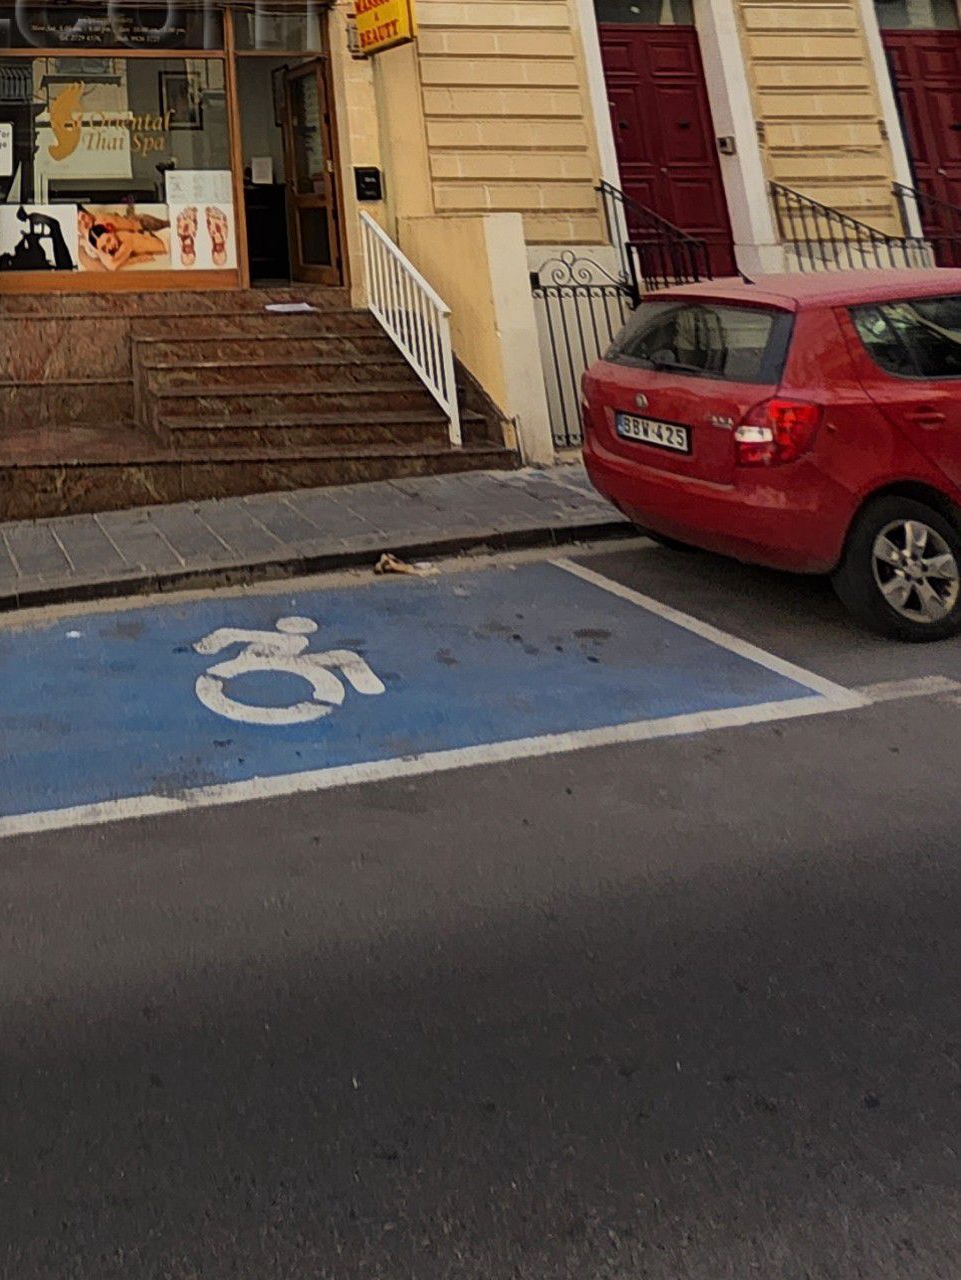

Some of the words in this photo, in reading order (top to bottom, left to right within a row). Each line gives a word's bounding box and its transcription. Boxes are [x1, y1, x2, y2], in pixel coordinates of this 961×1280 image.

[360, 18, 399, 48] BEAUTY
[89, 108, 176, 134] Oriental
[82, 131, 124, 151] Thai
[131, 131, 166, 157] Spa
